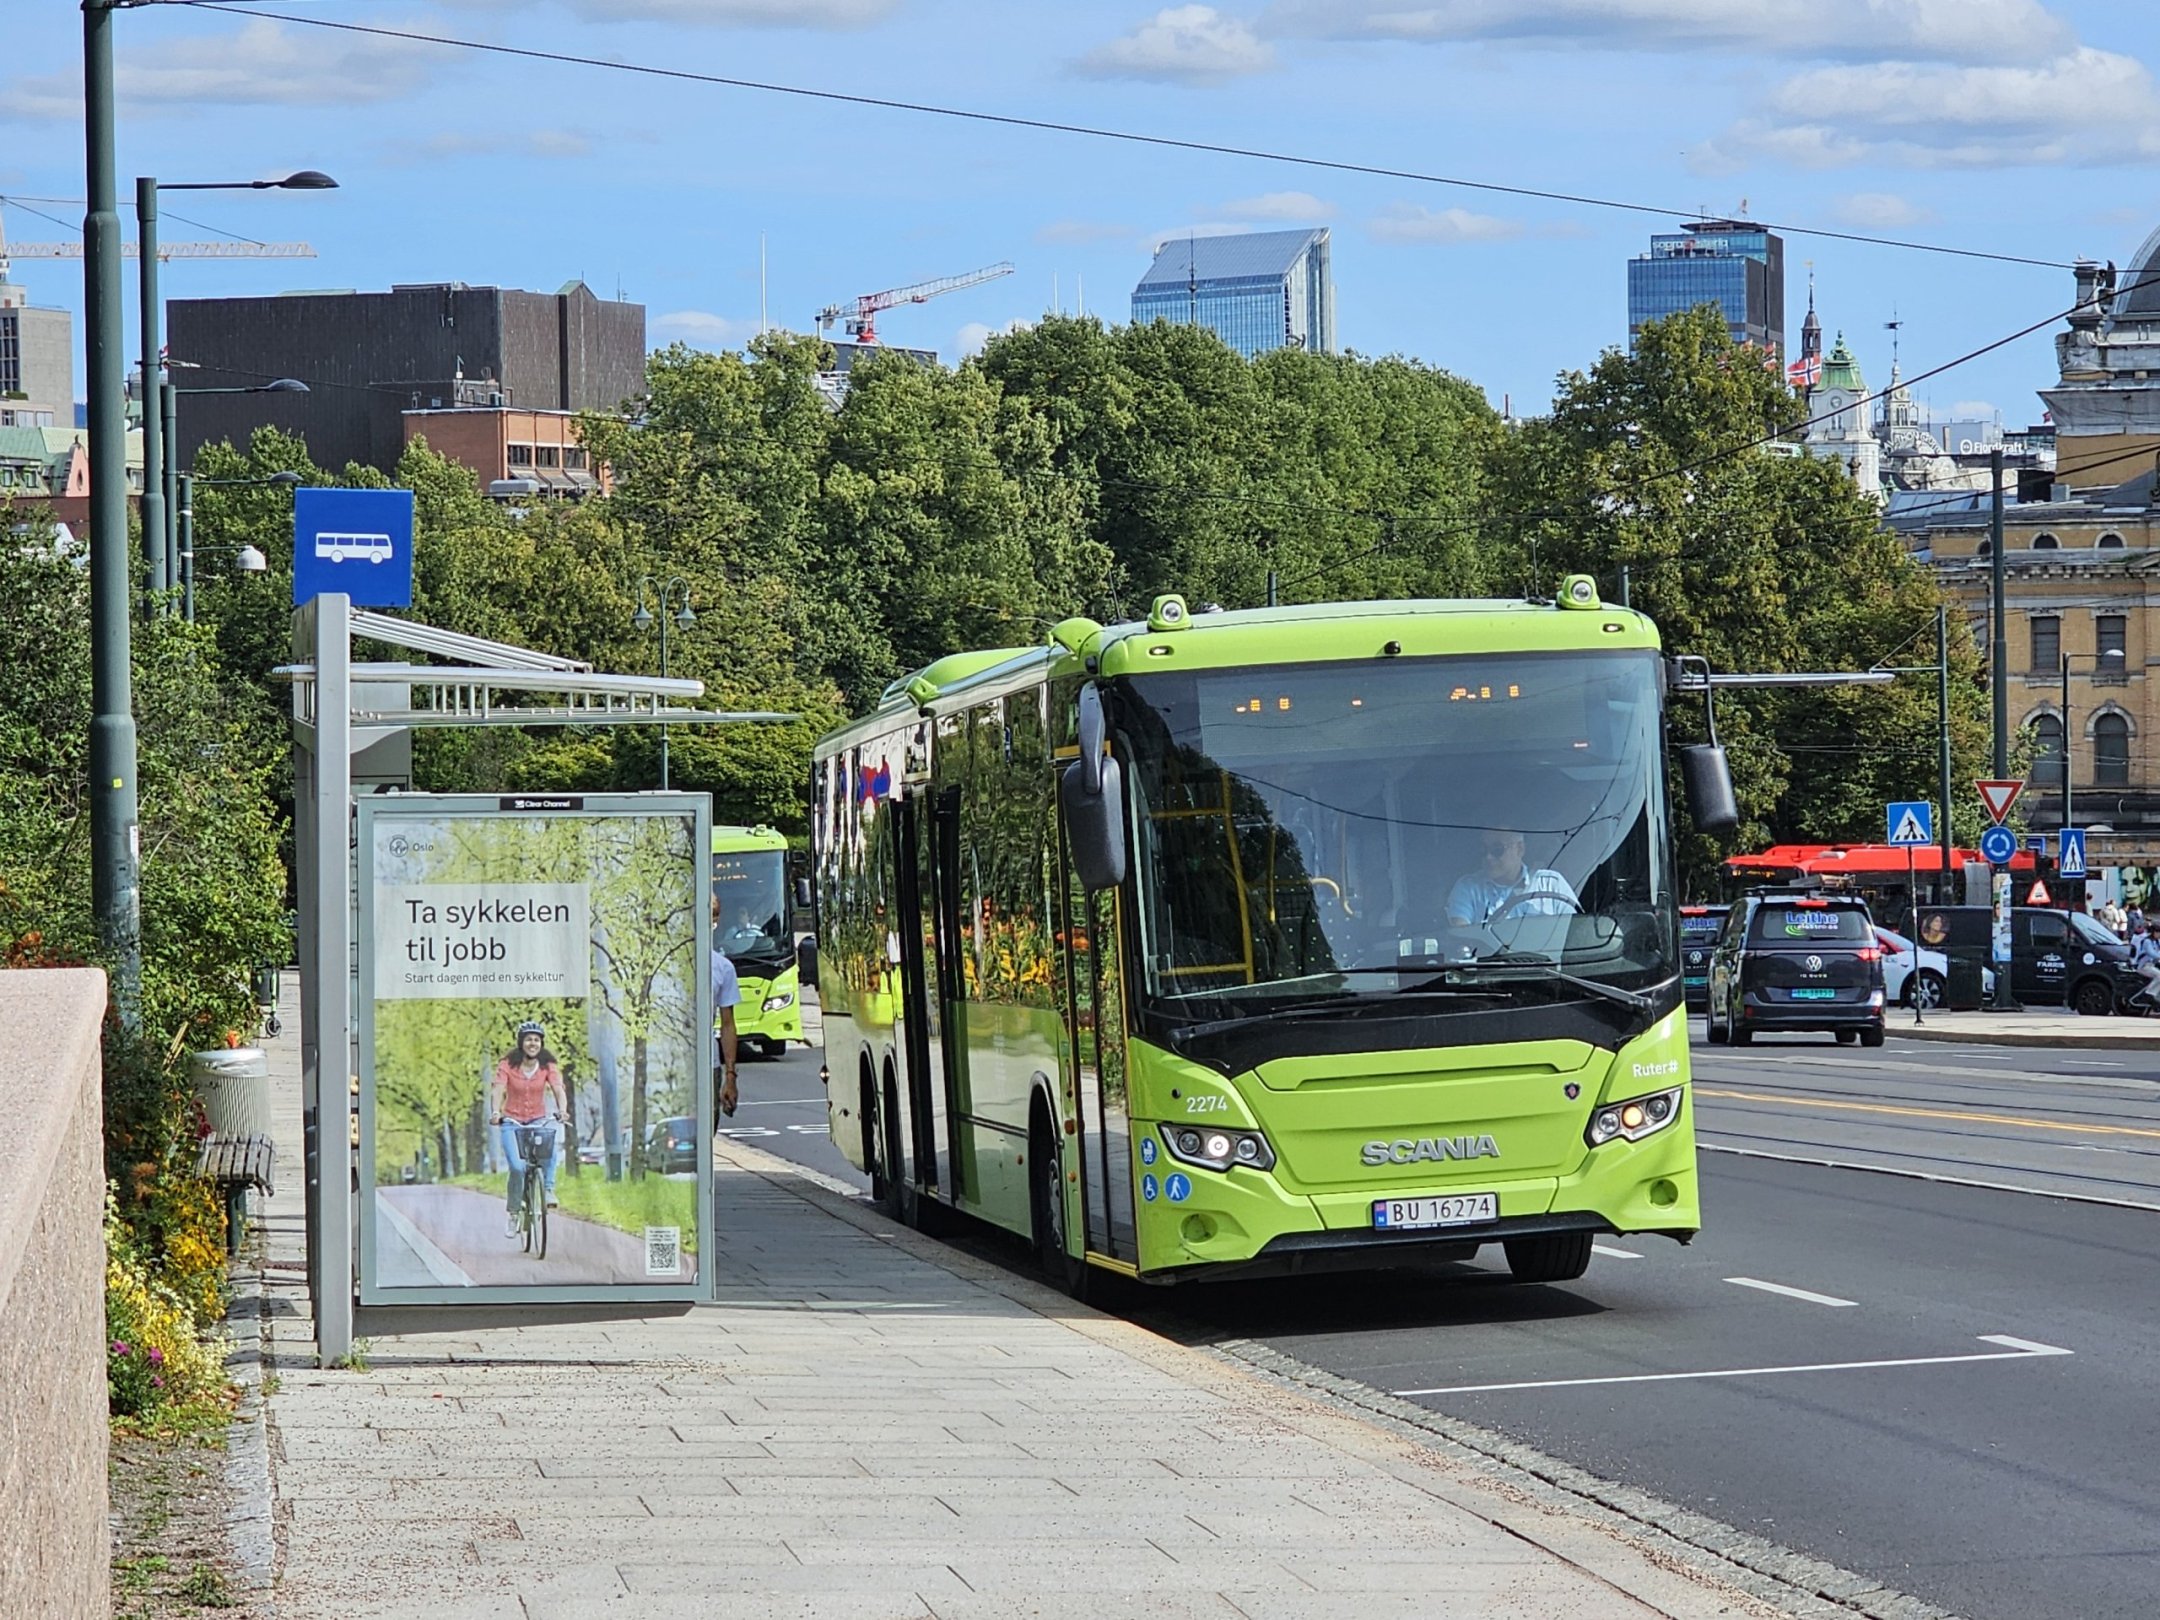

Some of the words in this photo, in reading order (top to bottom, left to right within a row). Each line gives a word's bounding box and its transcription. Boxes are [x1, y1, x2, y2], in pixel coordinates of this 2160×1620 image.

[525, 800, 542, 808] Clear
[543, 800, 570, 808] Channel
[412, 842, 434, 852] Oslo
[405, 899, 437, 924] Ta
[446, 898, 570, 930] sykkelen
[1785, 909, 1839, 925] Leithe
[405, 936, 436, 961] til
[442, 936, 507, 967] jobb
[405, 973, 434, 984] Start
[436, 973, 469, 985] dagen
[472, 973, 496, 983] med
[498, 975, 511, 983] en
[514, 972, 565, 985] sykkeltur
[1186, 1095, 1228, 1114] 2274
[1360, 1134, 1500, 1167] SCANIA
[1393, 1202, 1420, 1222] BU
[1430, 1196, 1491, 1219] 16274
